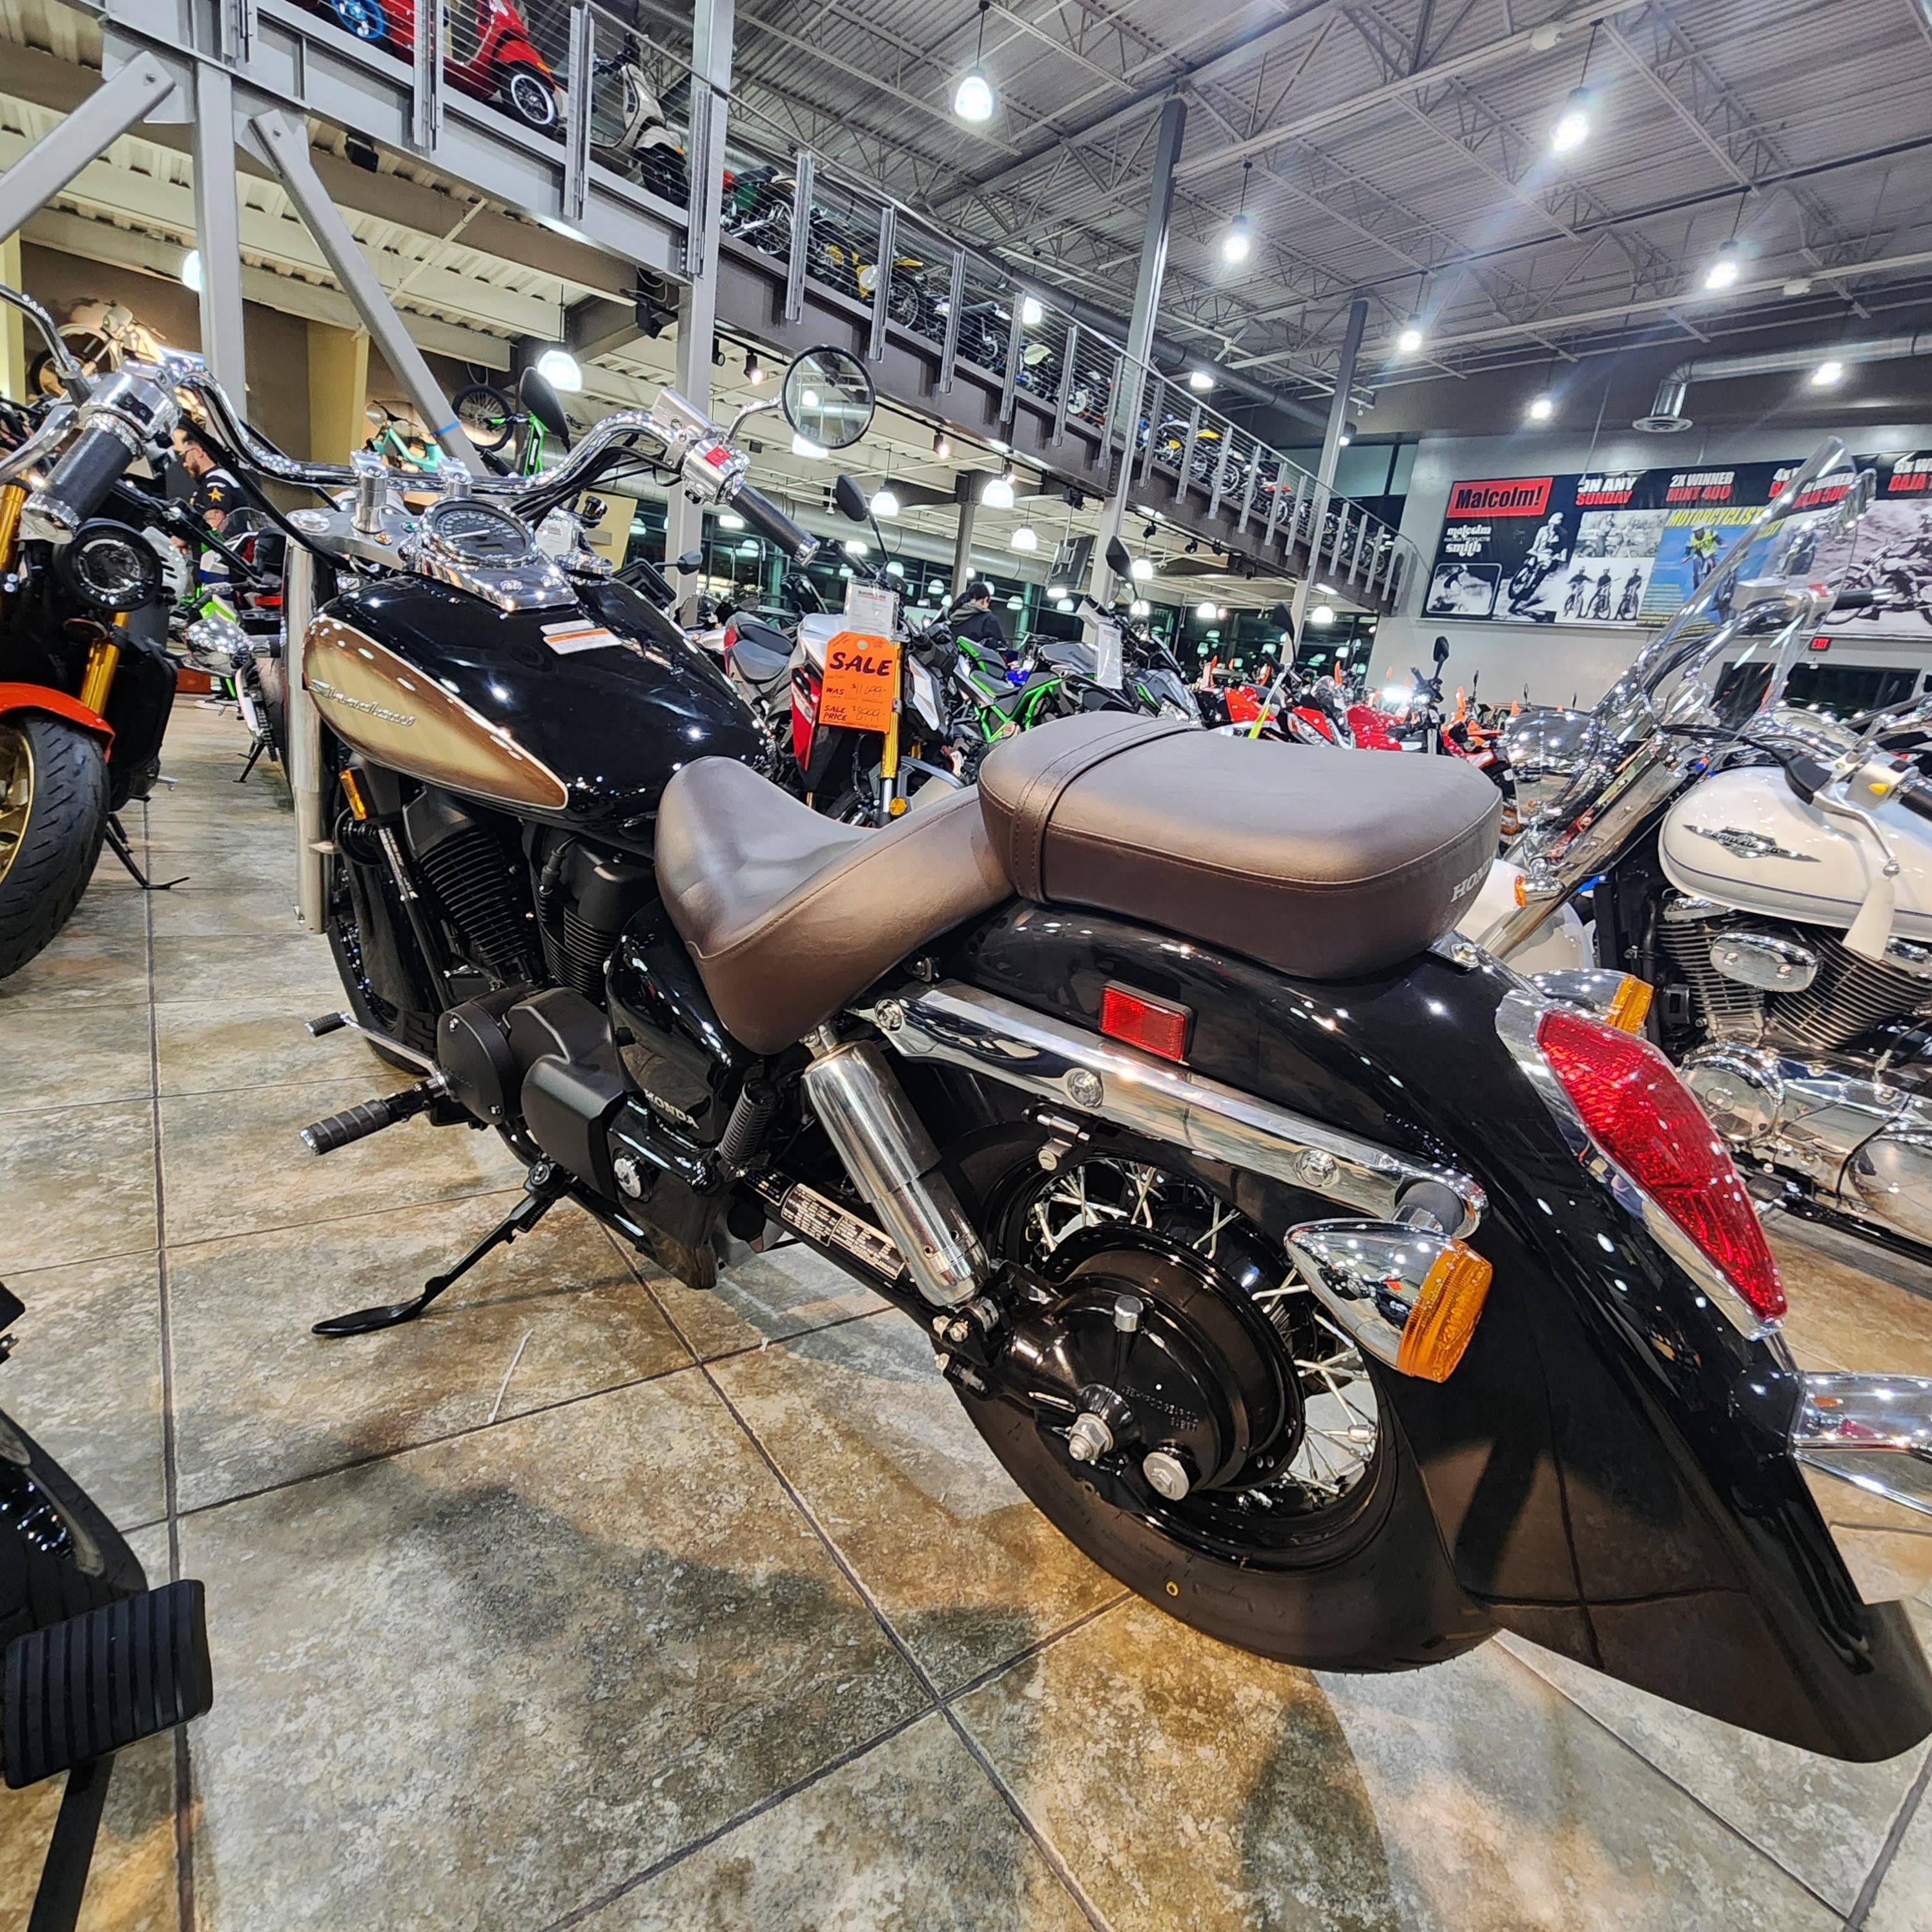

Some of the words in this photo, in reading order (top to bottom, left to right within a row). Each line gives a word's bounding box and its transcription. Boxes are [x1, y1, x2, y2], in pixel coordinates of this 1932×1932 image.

[1601, 476, 1638, 492] ANY
[1686, 471, 1735, 488] WINNER
[1887, 473, 1927, 491] BAJA
[1455, 485, 1544, 509] Malcolm!
[1575, 490, 1634, 506] SUNDAY
[1665, 487, 1701, 502] MINT
[1701, 485, 1732, 500] 400
[1665, 506, 1765, 527] MOTORCYCLIST
[829, 652, 893, 677] SALE
[826, 687, 845, 695] WAS
[823, 712, 847, 721] PRICE
[824, 705, 846, 714] SALE
[643, 1088, 700, 1129] HONDA
